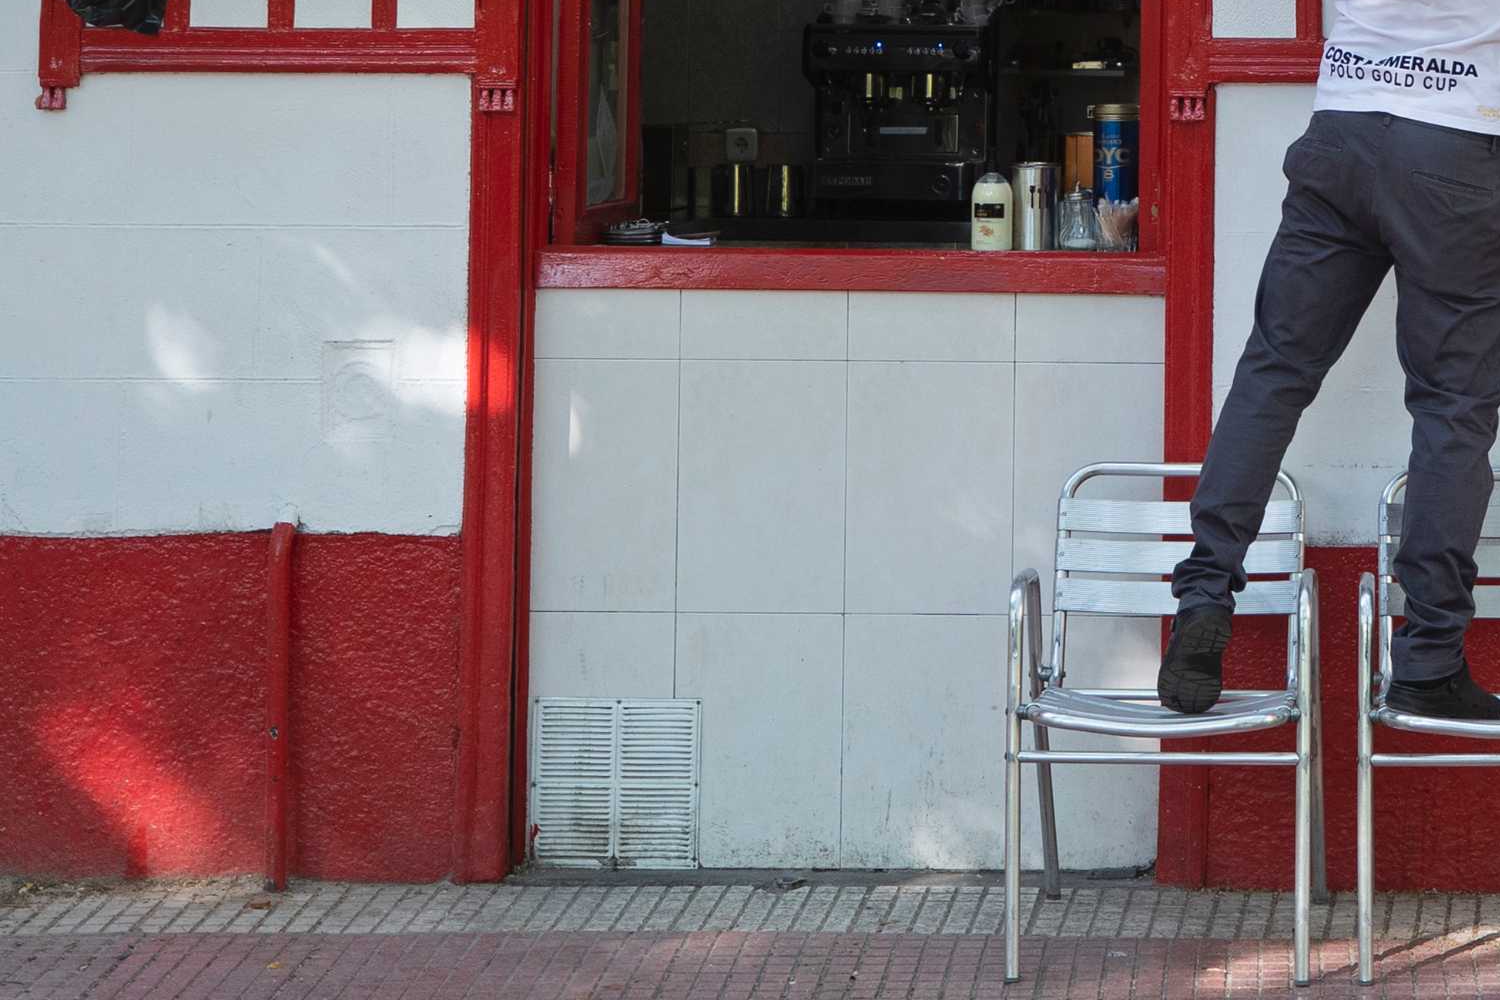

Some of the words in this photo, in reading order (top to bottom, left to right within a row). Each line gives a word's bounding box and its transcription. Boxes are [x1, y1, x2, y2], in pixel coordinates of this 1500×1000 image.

[1329, 63, 1365, 79] POLO
[1371, 69, 1415, 88] GOLD
[1423, 76, 1458, 92] CUP
